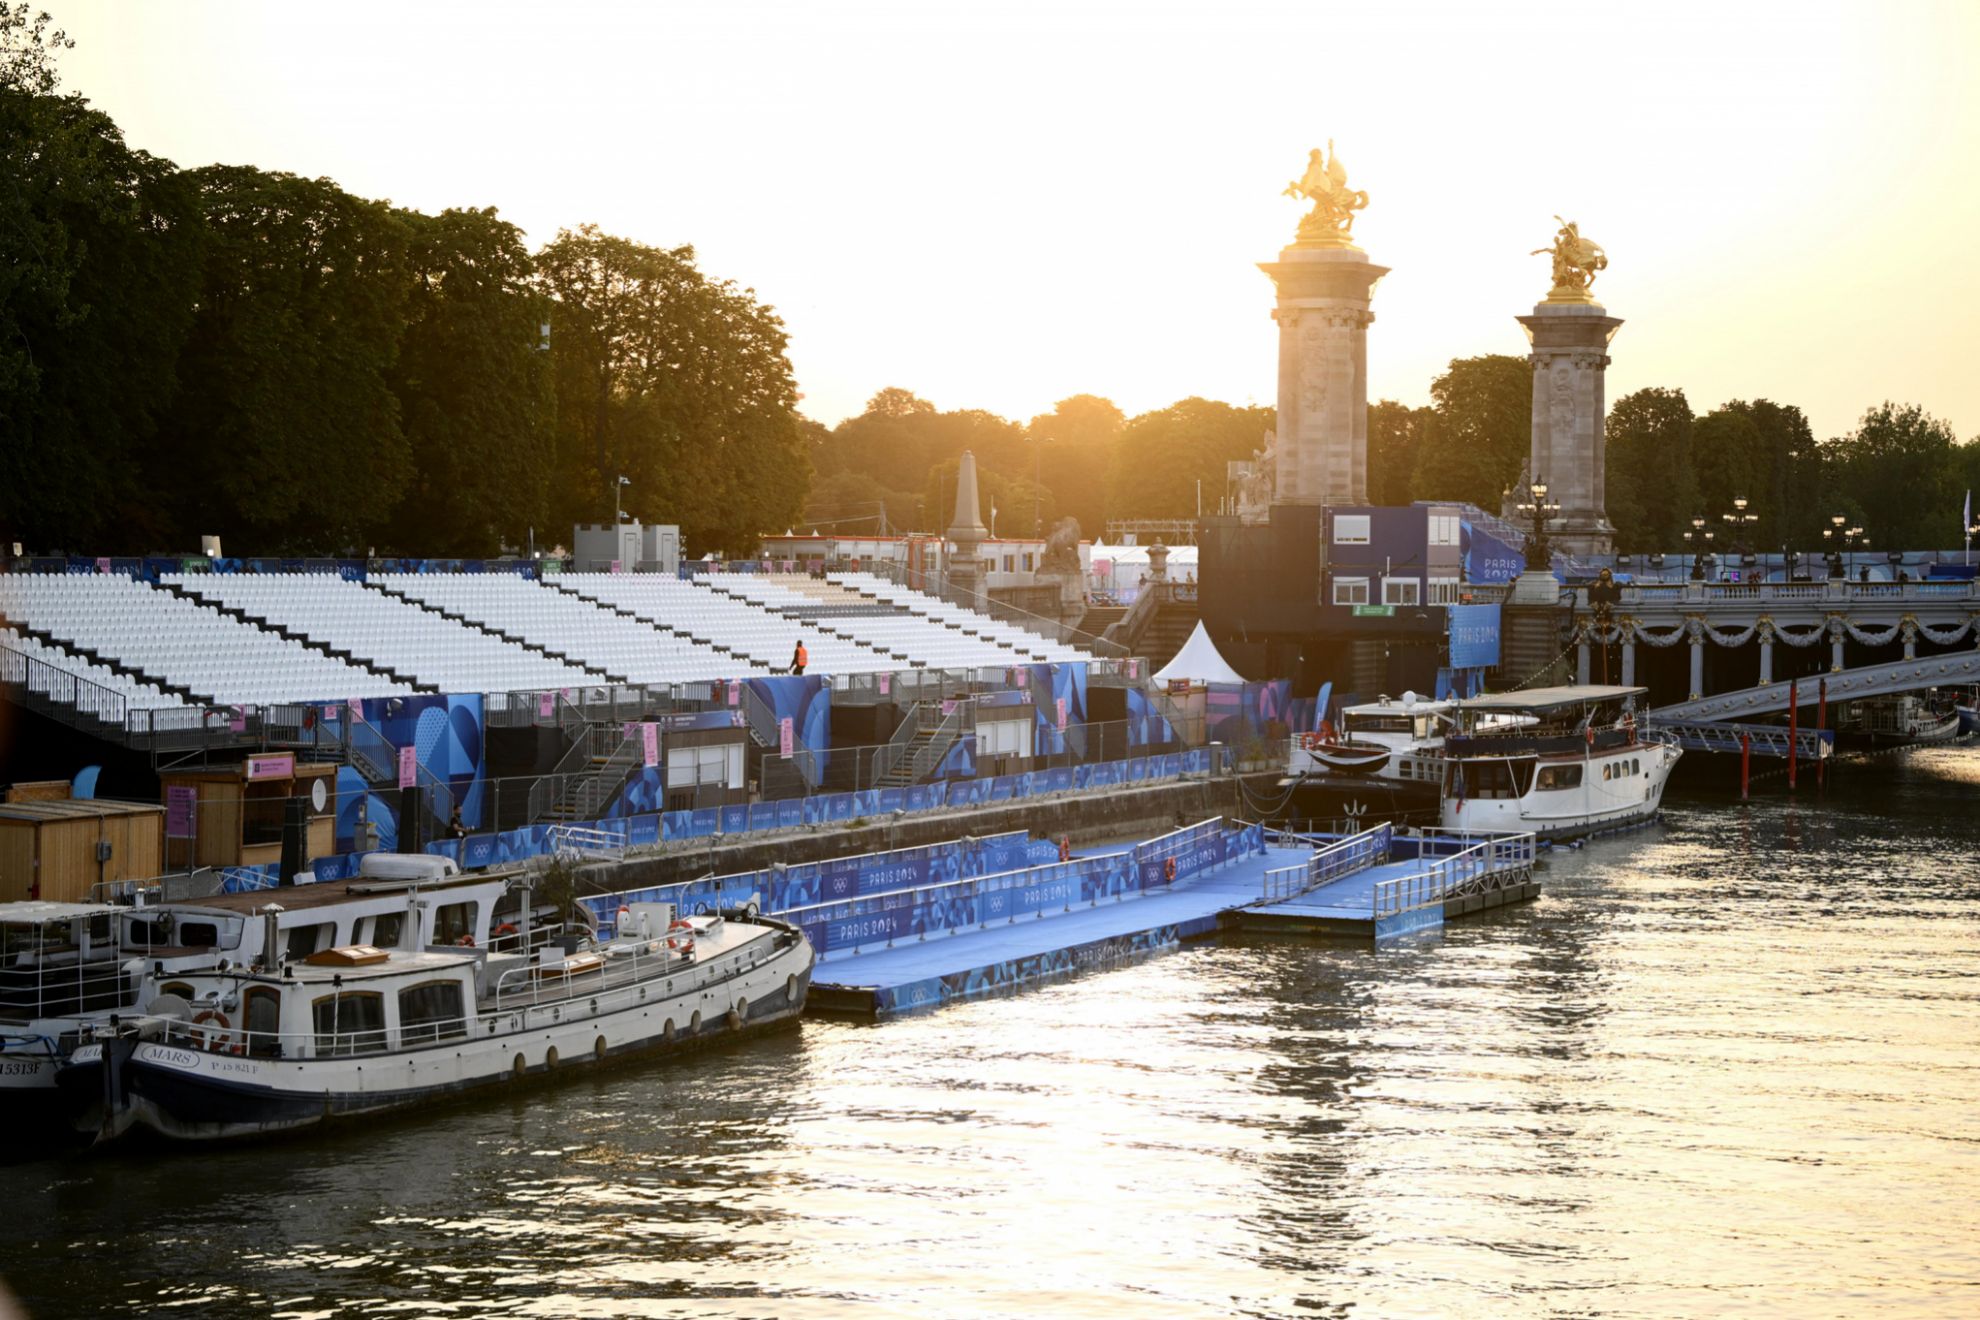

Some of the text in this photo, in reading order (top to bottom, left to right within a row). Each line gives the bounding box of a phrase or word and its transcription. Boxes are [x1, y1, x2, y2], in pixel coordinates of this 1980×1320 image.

[1484, 558, 1517, 569] PARIS
[1484, 570, 1517, 579] 2024
[1177, 847, 1217, 873] PARIS 2024
[869, 866, 918, 887] PARIS 2024
[1024, 883, 1072, 905] PARIS 2024
[841, 921, 869, 940] PARIS
[872, 916, 897, 935] 2024
[149, 1048, 191, 1065] MARS
[0, 1063, 42, 1076] 15313F
[211, 1061, 219, 1071] P
[235, 1062, 250, 1074] 821
